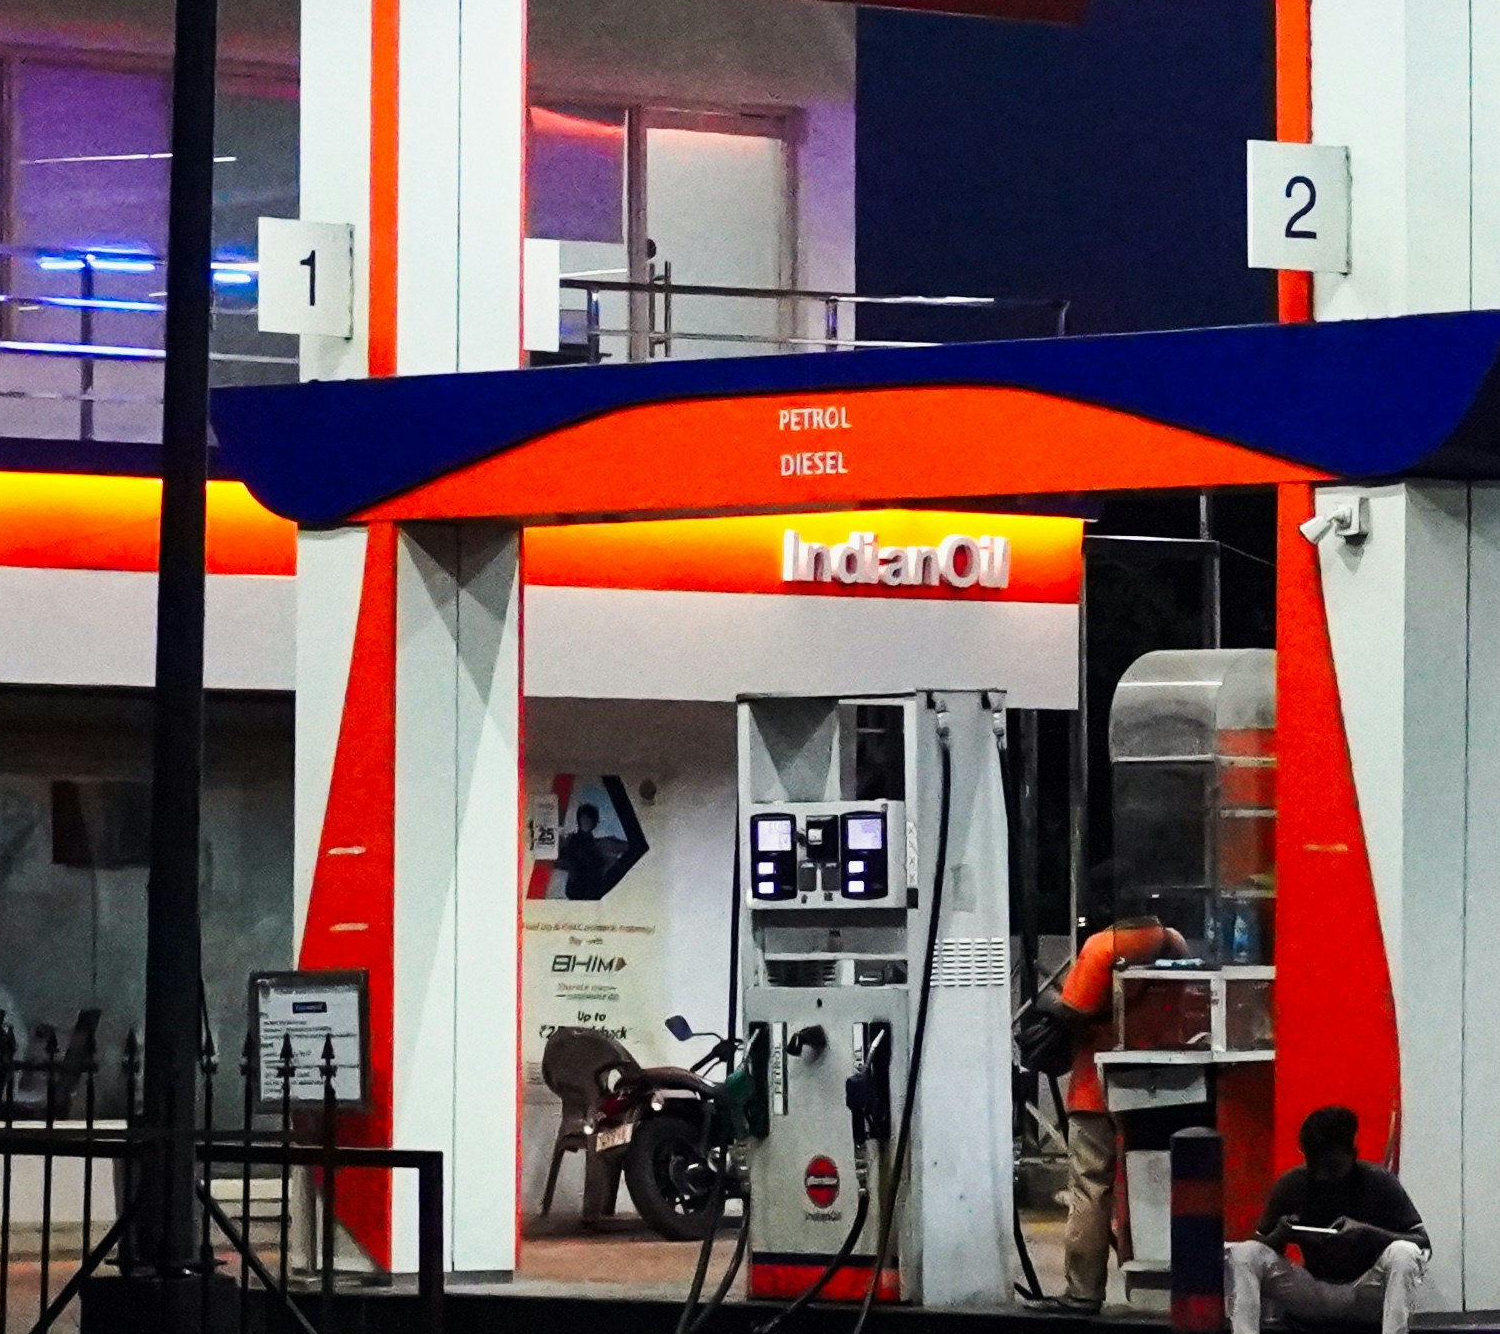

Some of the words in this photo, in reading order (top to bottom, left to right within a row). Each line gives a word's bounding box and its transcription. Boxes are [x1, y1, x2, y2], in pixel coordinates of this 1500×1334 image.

[1284, 175, 1318, 239] 2
[299, 249, 316, 307] 1
[779, 406, 852, 431] PETROL
[780, 451, 848, 476] DIESEL
[782, 528, 1010, 589] IndianOil
[577, 1011, 591, 1022] Up
[594, 1011, 607, 1021] to
